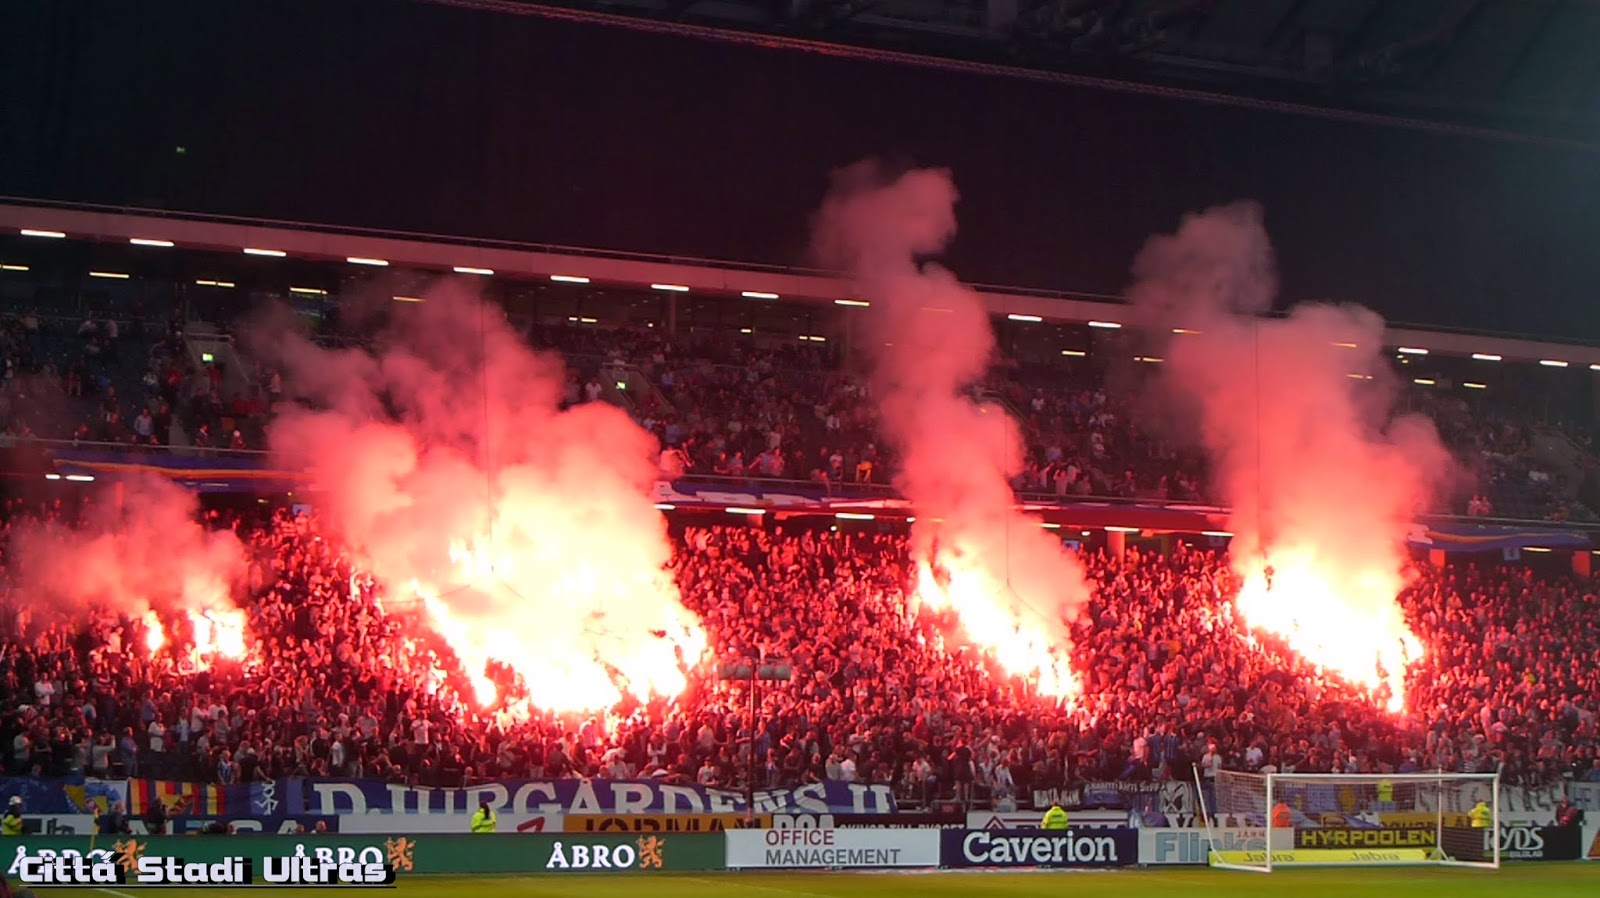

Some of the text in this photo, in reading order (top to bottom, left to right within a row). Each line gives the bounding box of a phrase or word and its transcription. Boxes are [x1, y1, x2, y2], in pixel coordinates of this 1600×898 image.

[766, 829, 835, 846] OFFICE
[1301, 830, 1436, 846] HYRPOOLEN
[546, 841, 635, 869] ÅBRO
[963, 830, 1119, 863] Caverion
[765, 848, 901, 865] MANAGEMENT
[1350, 852, 1400, 861] Jabra
